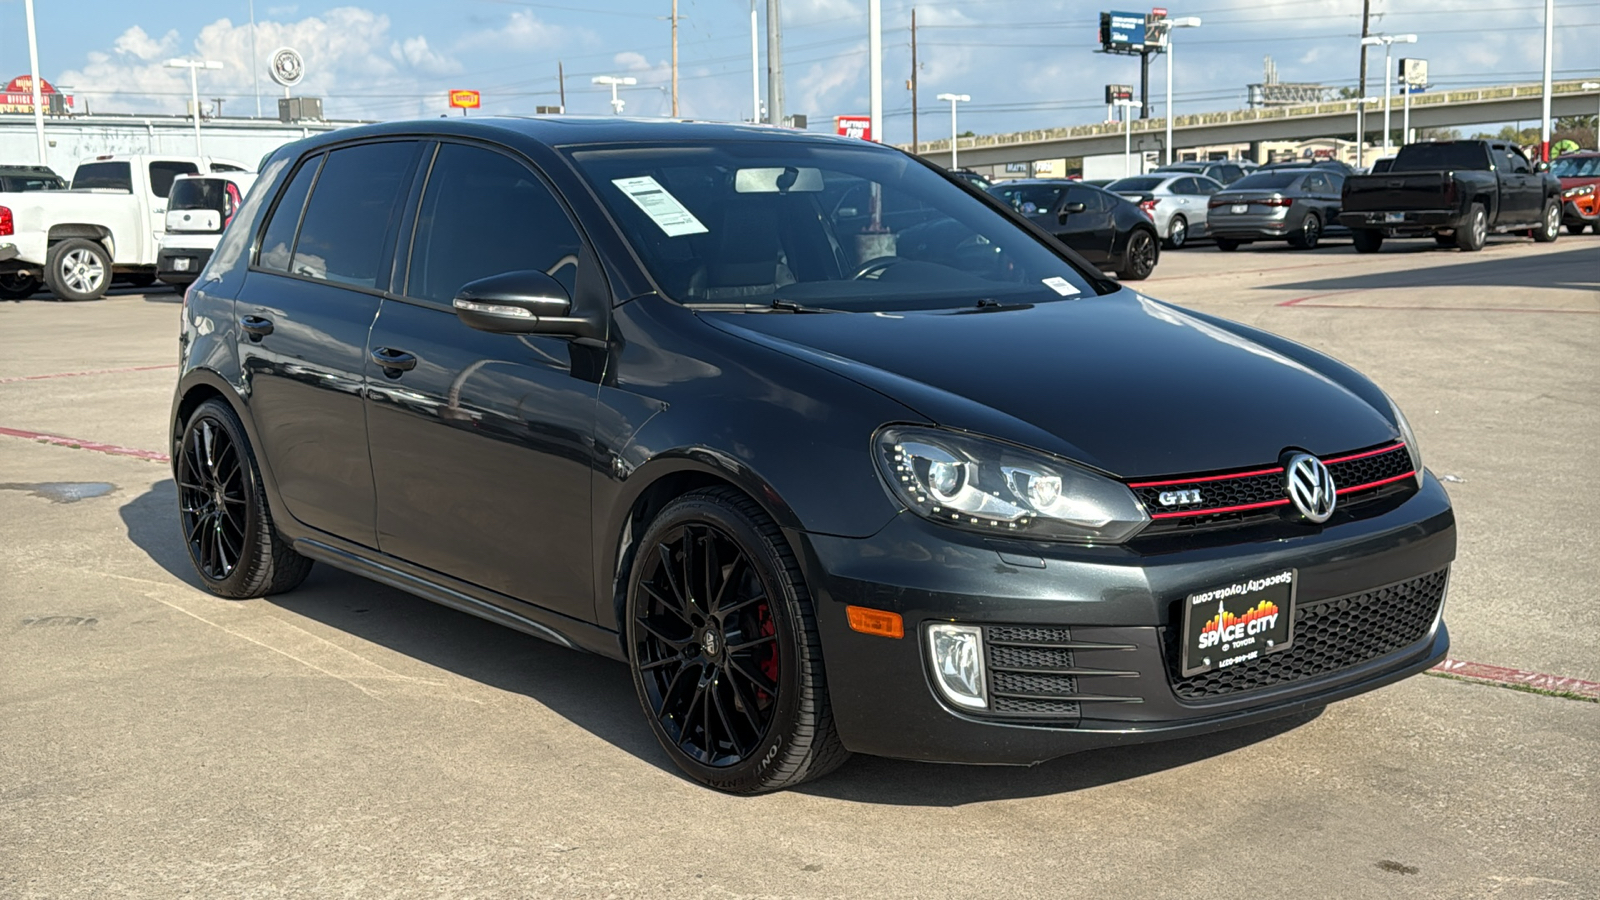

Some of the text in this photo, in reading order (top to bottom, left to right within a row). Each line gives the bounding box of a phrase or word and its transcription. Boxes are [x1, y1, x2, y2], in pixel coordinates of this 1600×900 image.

[1158, 489, 1202, 506] GTI
[1192, 571, 1293, 605] SpaceCityToyota.com
[1198, 612, 1279, 649] SPACE CITY
[1232, 637, 1255, 648] TOYOTA
